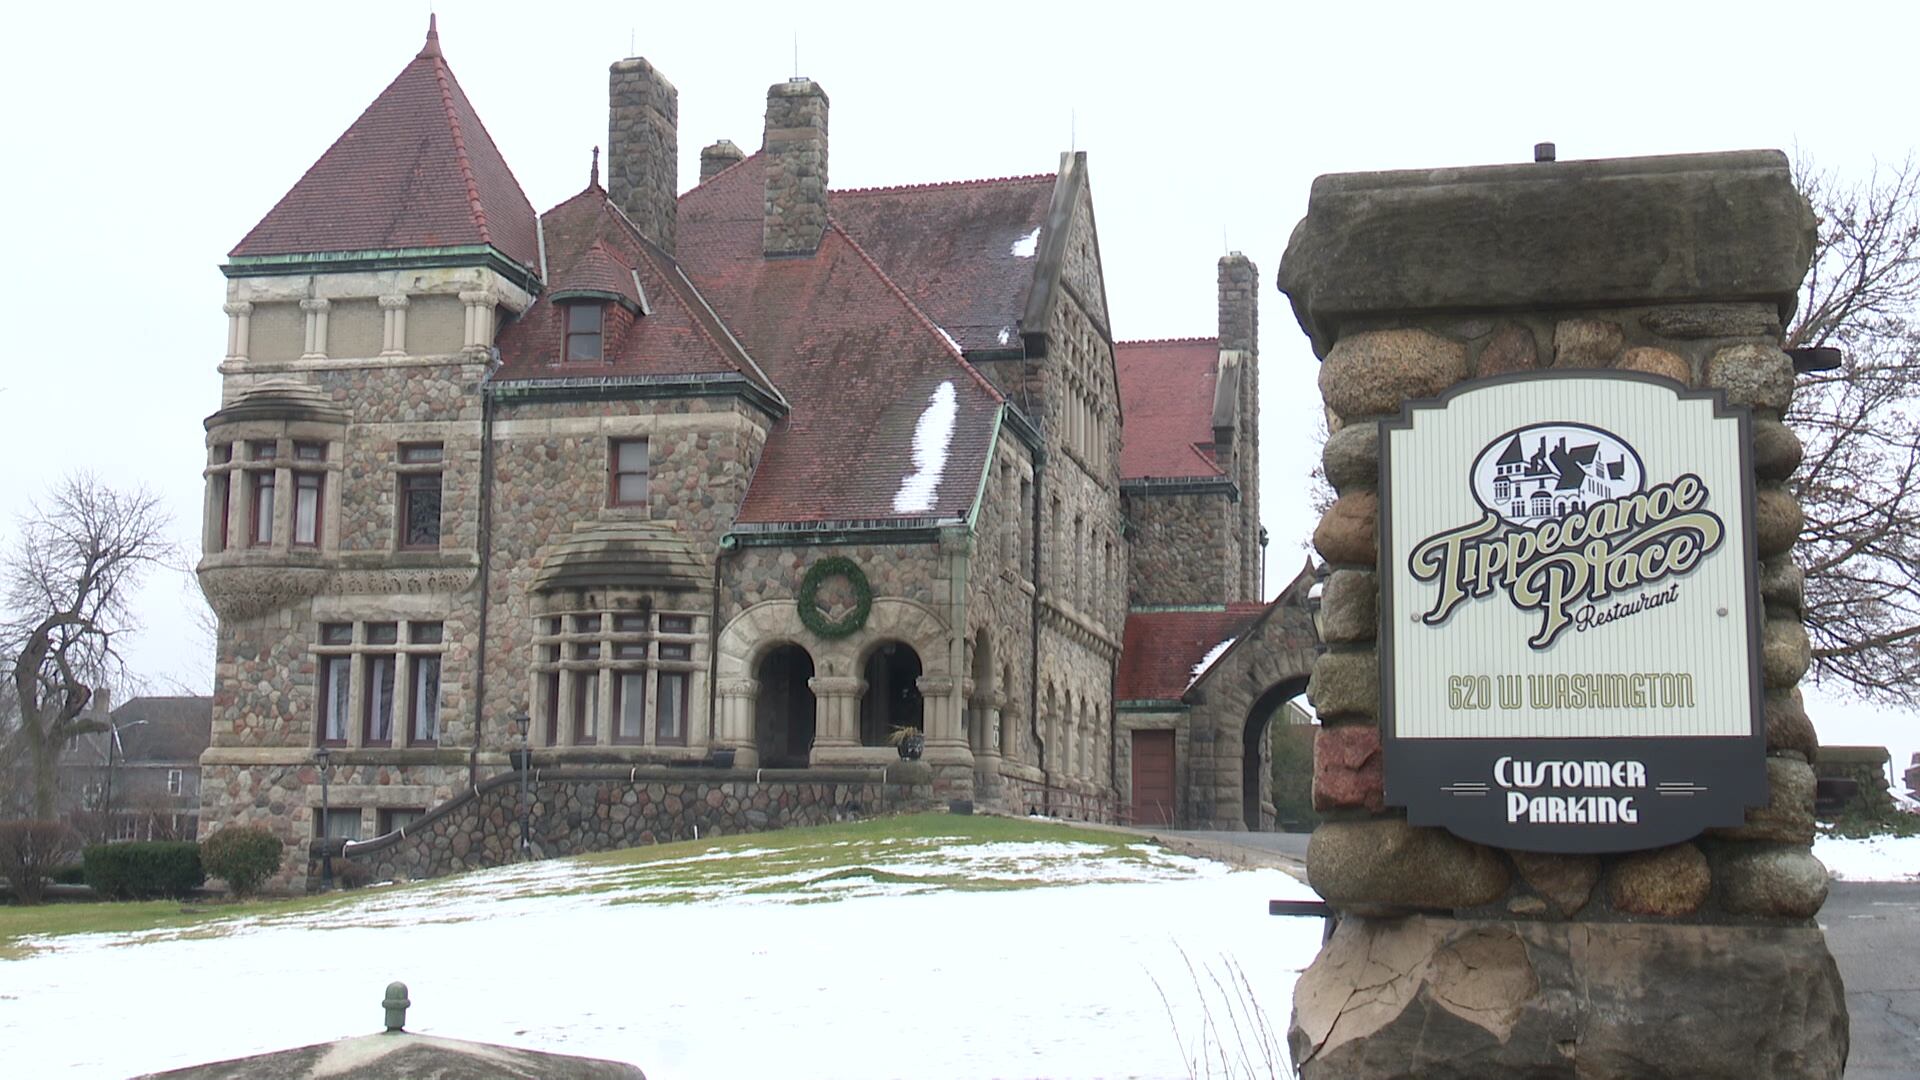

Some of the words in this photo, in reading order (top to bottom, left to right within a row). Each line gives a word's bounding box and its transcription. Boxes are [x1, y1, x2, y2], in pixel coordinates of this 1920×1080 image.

[1409, 475, 1708, 624] Tippecanoe
[1511, 511, 1724, 649] Place
[1575, 584, 1679, 632] Restaurant
[1449, 675, 1491, 710] 620
[1498, 675, 1522, 709] W
[1529, 673, 1695, 709] WASHINGTON
[1494, 757, 1646, 788] CUSTOMER
[1507, 793, 1638, 823] PARKING
